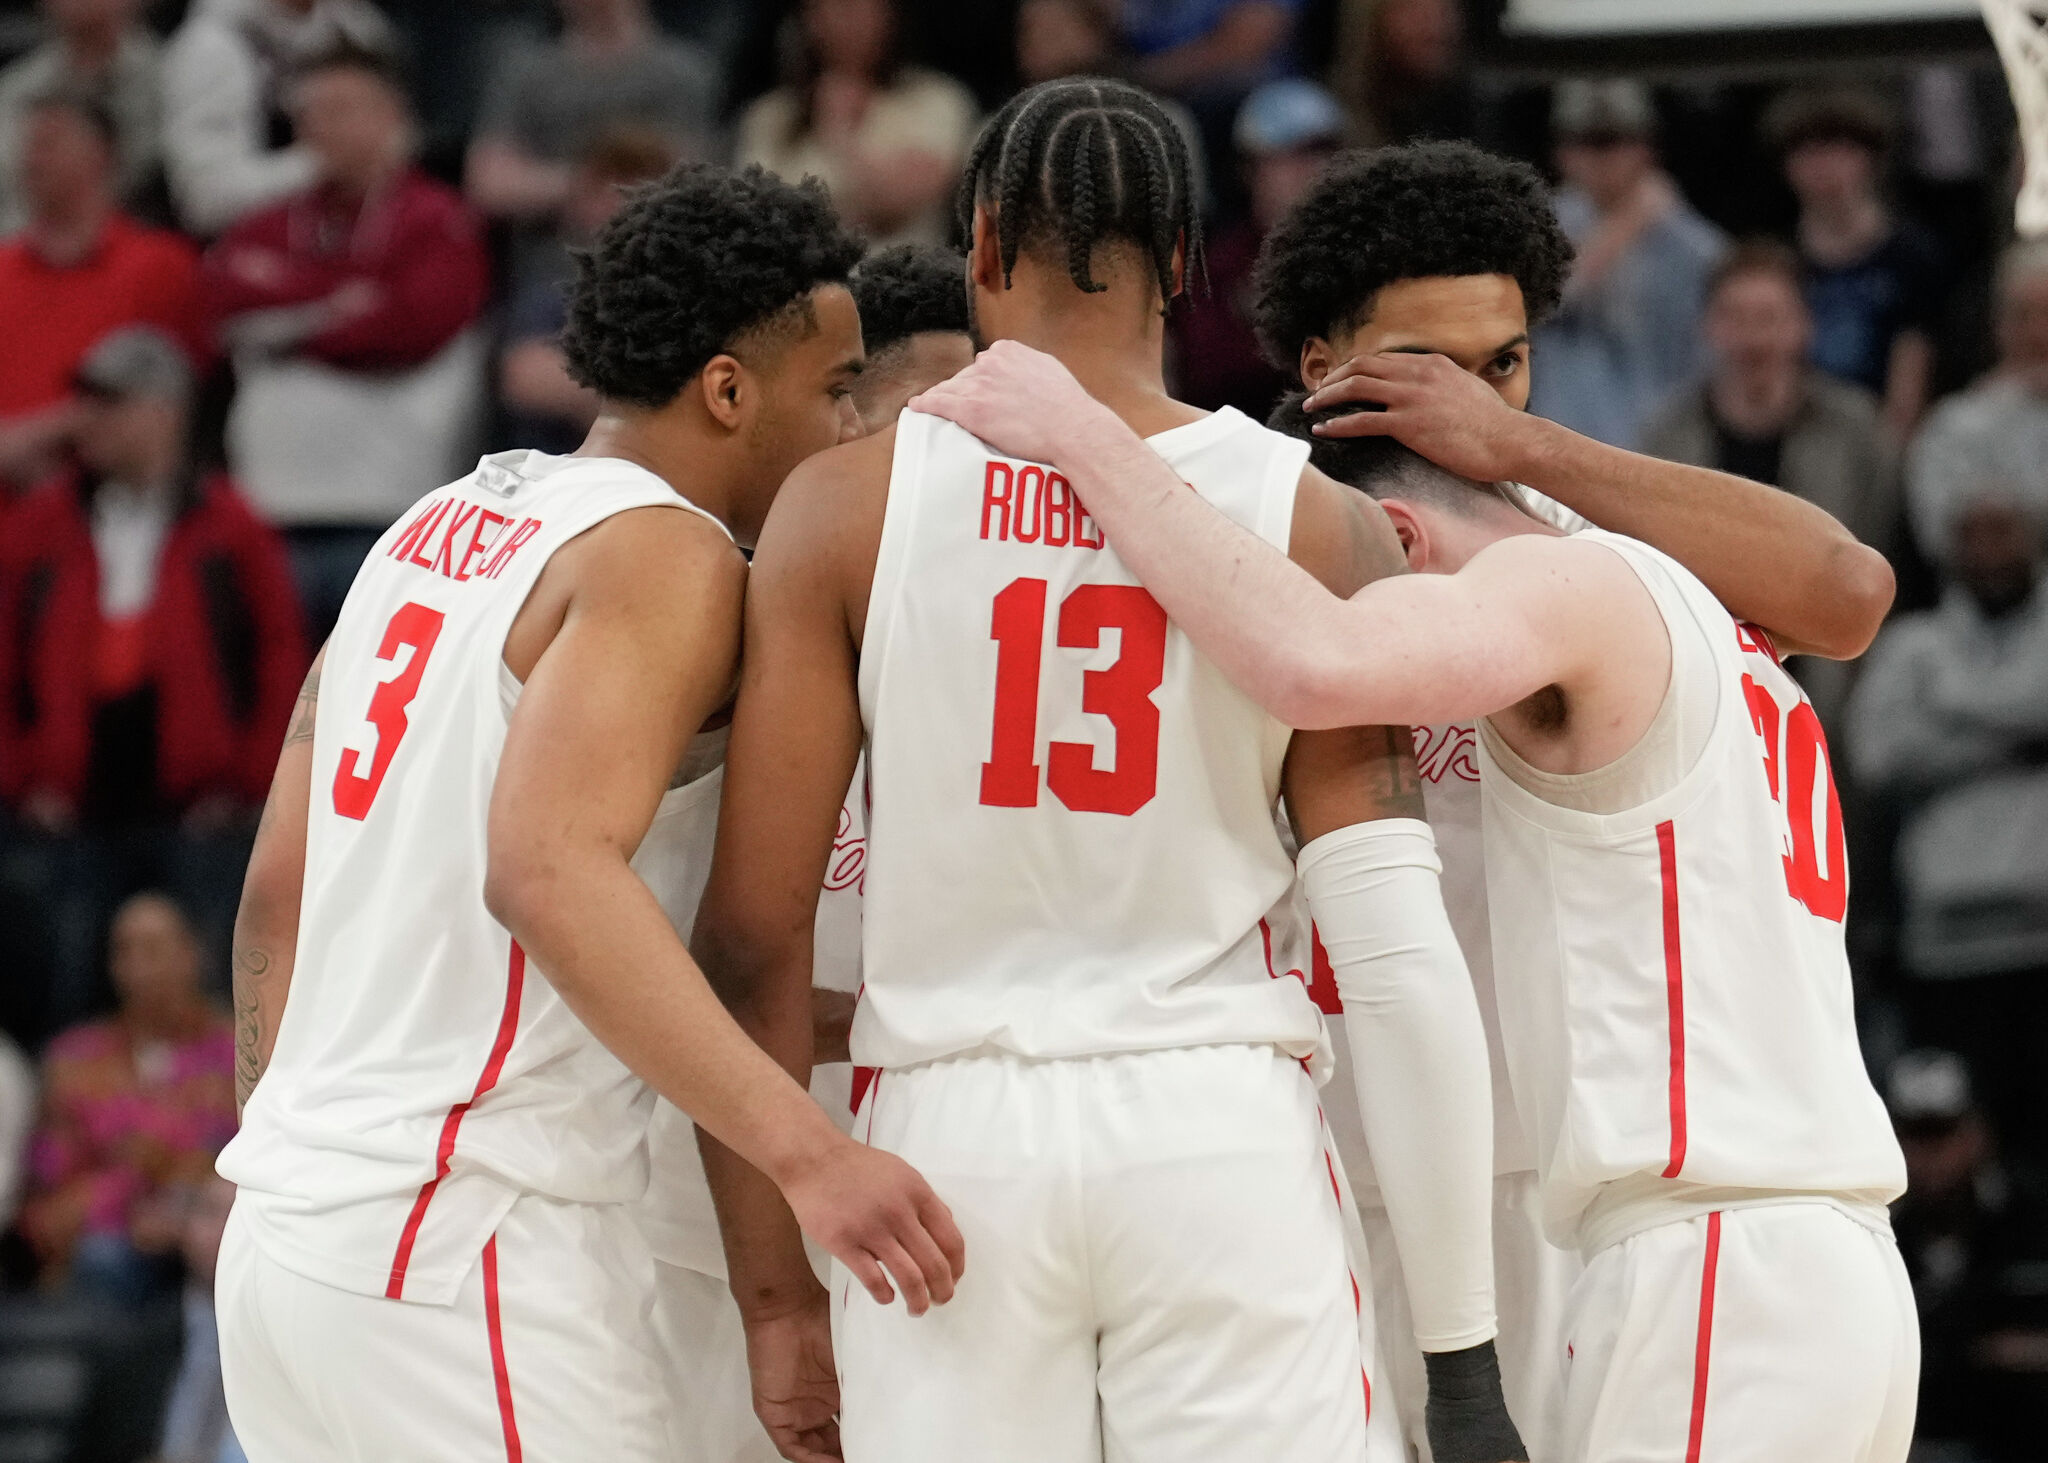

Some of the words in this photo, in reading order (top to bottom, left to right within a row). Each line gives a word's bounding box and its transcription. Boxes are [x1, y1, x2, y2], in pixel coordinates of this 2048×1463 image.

[979, 461, 1106, 551] ROBE
[332, 601, 446, 822] 3
[979, 576, 1170, 817] 13
